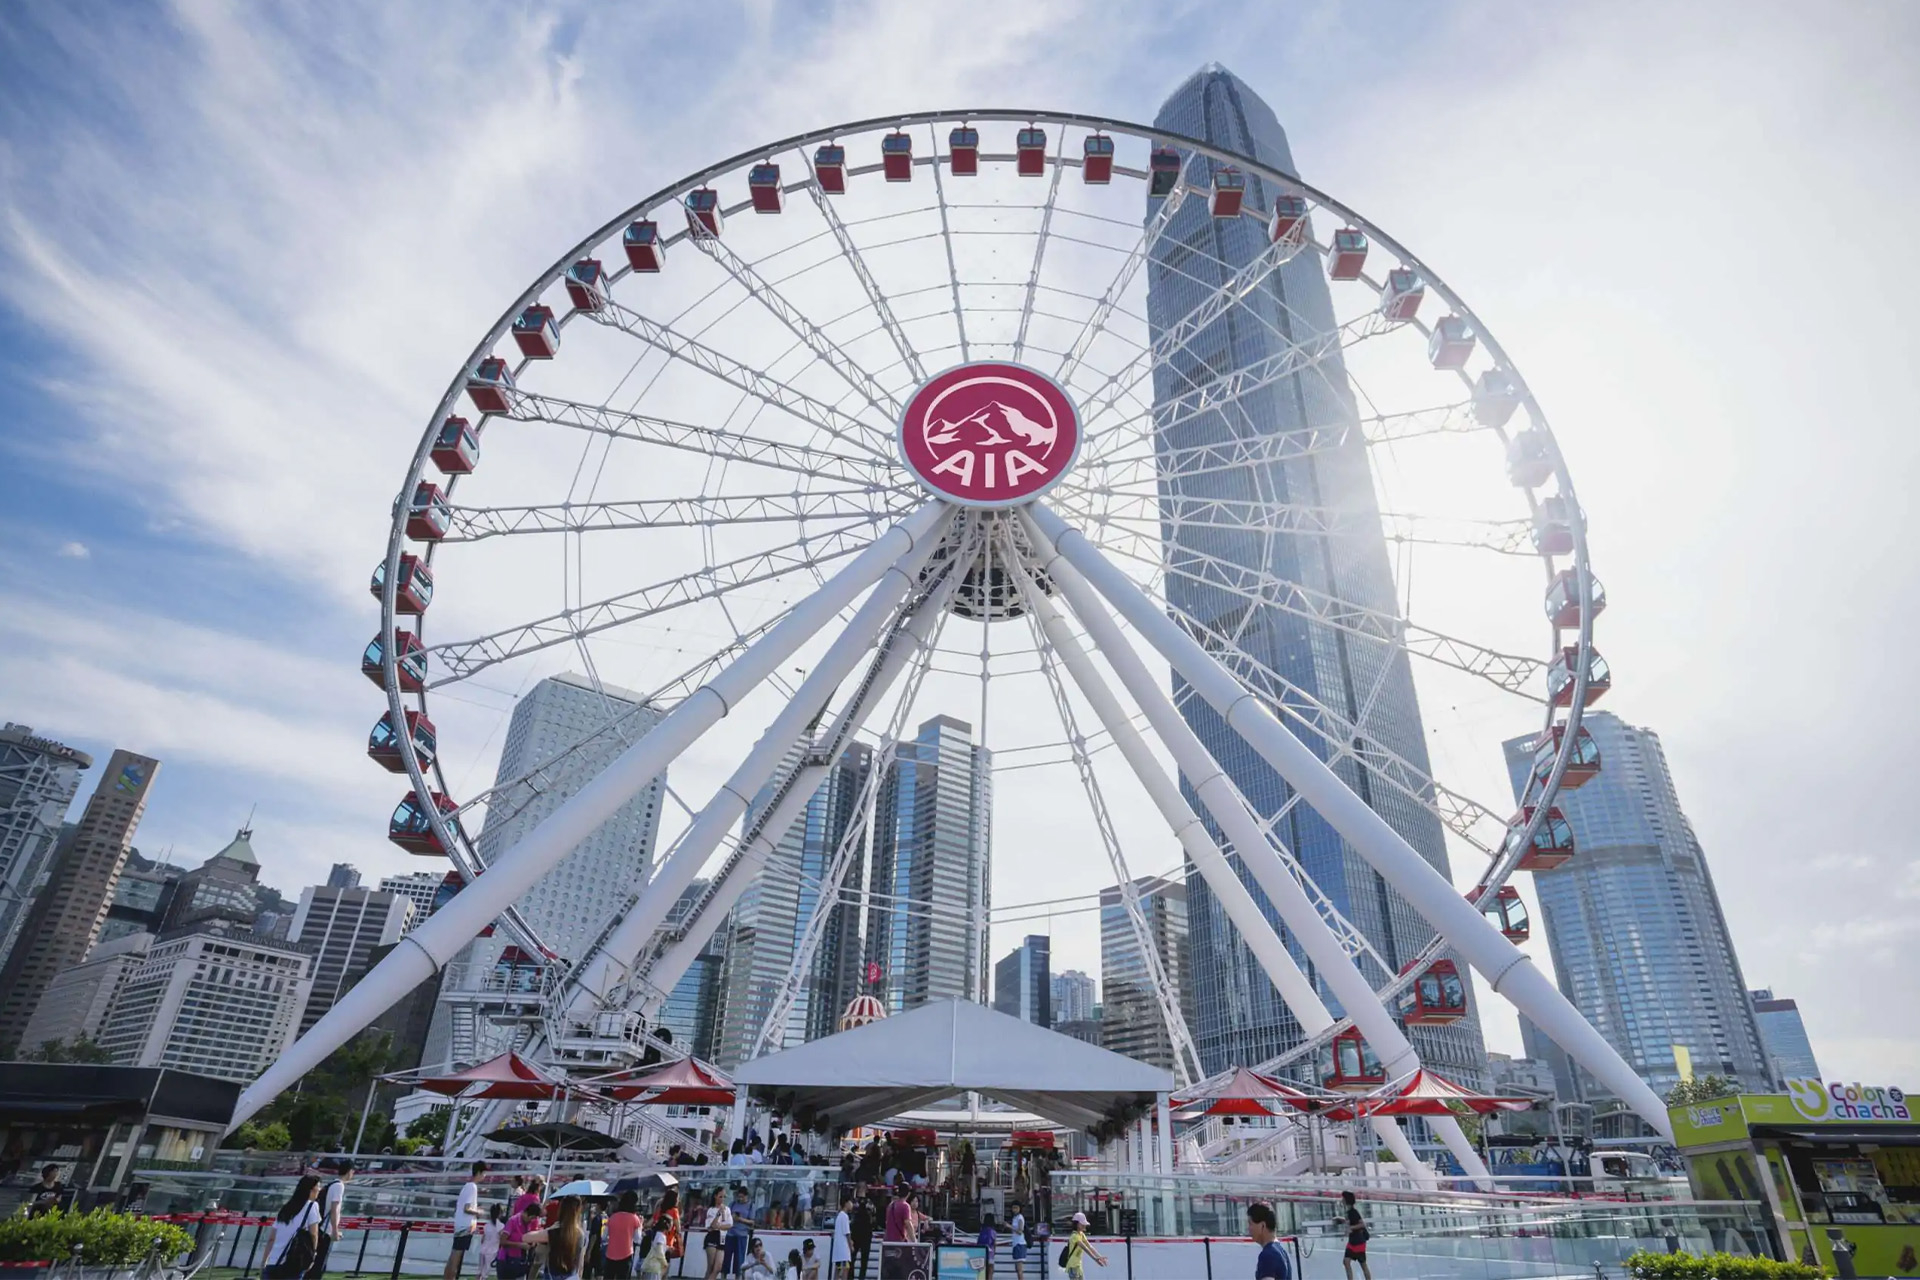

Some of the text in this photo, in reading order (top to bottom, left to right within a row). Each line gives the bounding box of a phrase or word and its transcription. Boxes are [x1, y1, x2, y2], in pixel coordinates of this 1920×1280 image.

[931, 449, 1049, 489] AIA
[1830, 1082, 1885, 1101] Color
[1834, 1103, 1909, 1119] chacha
